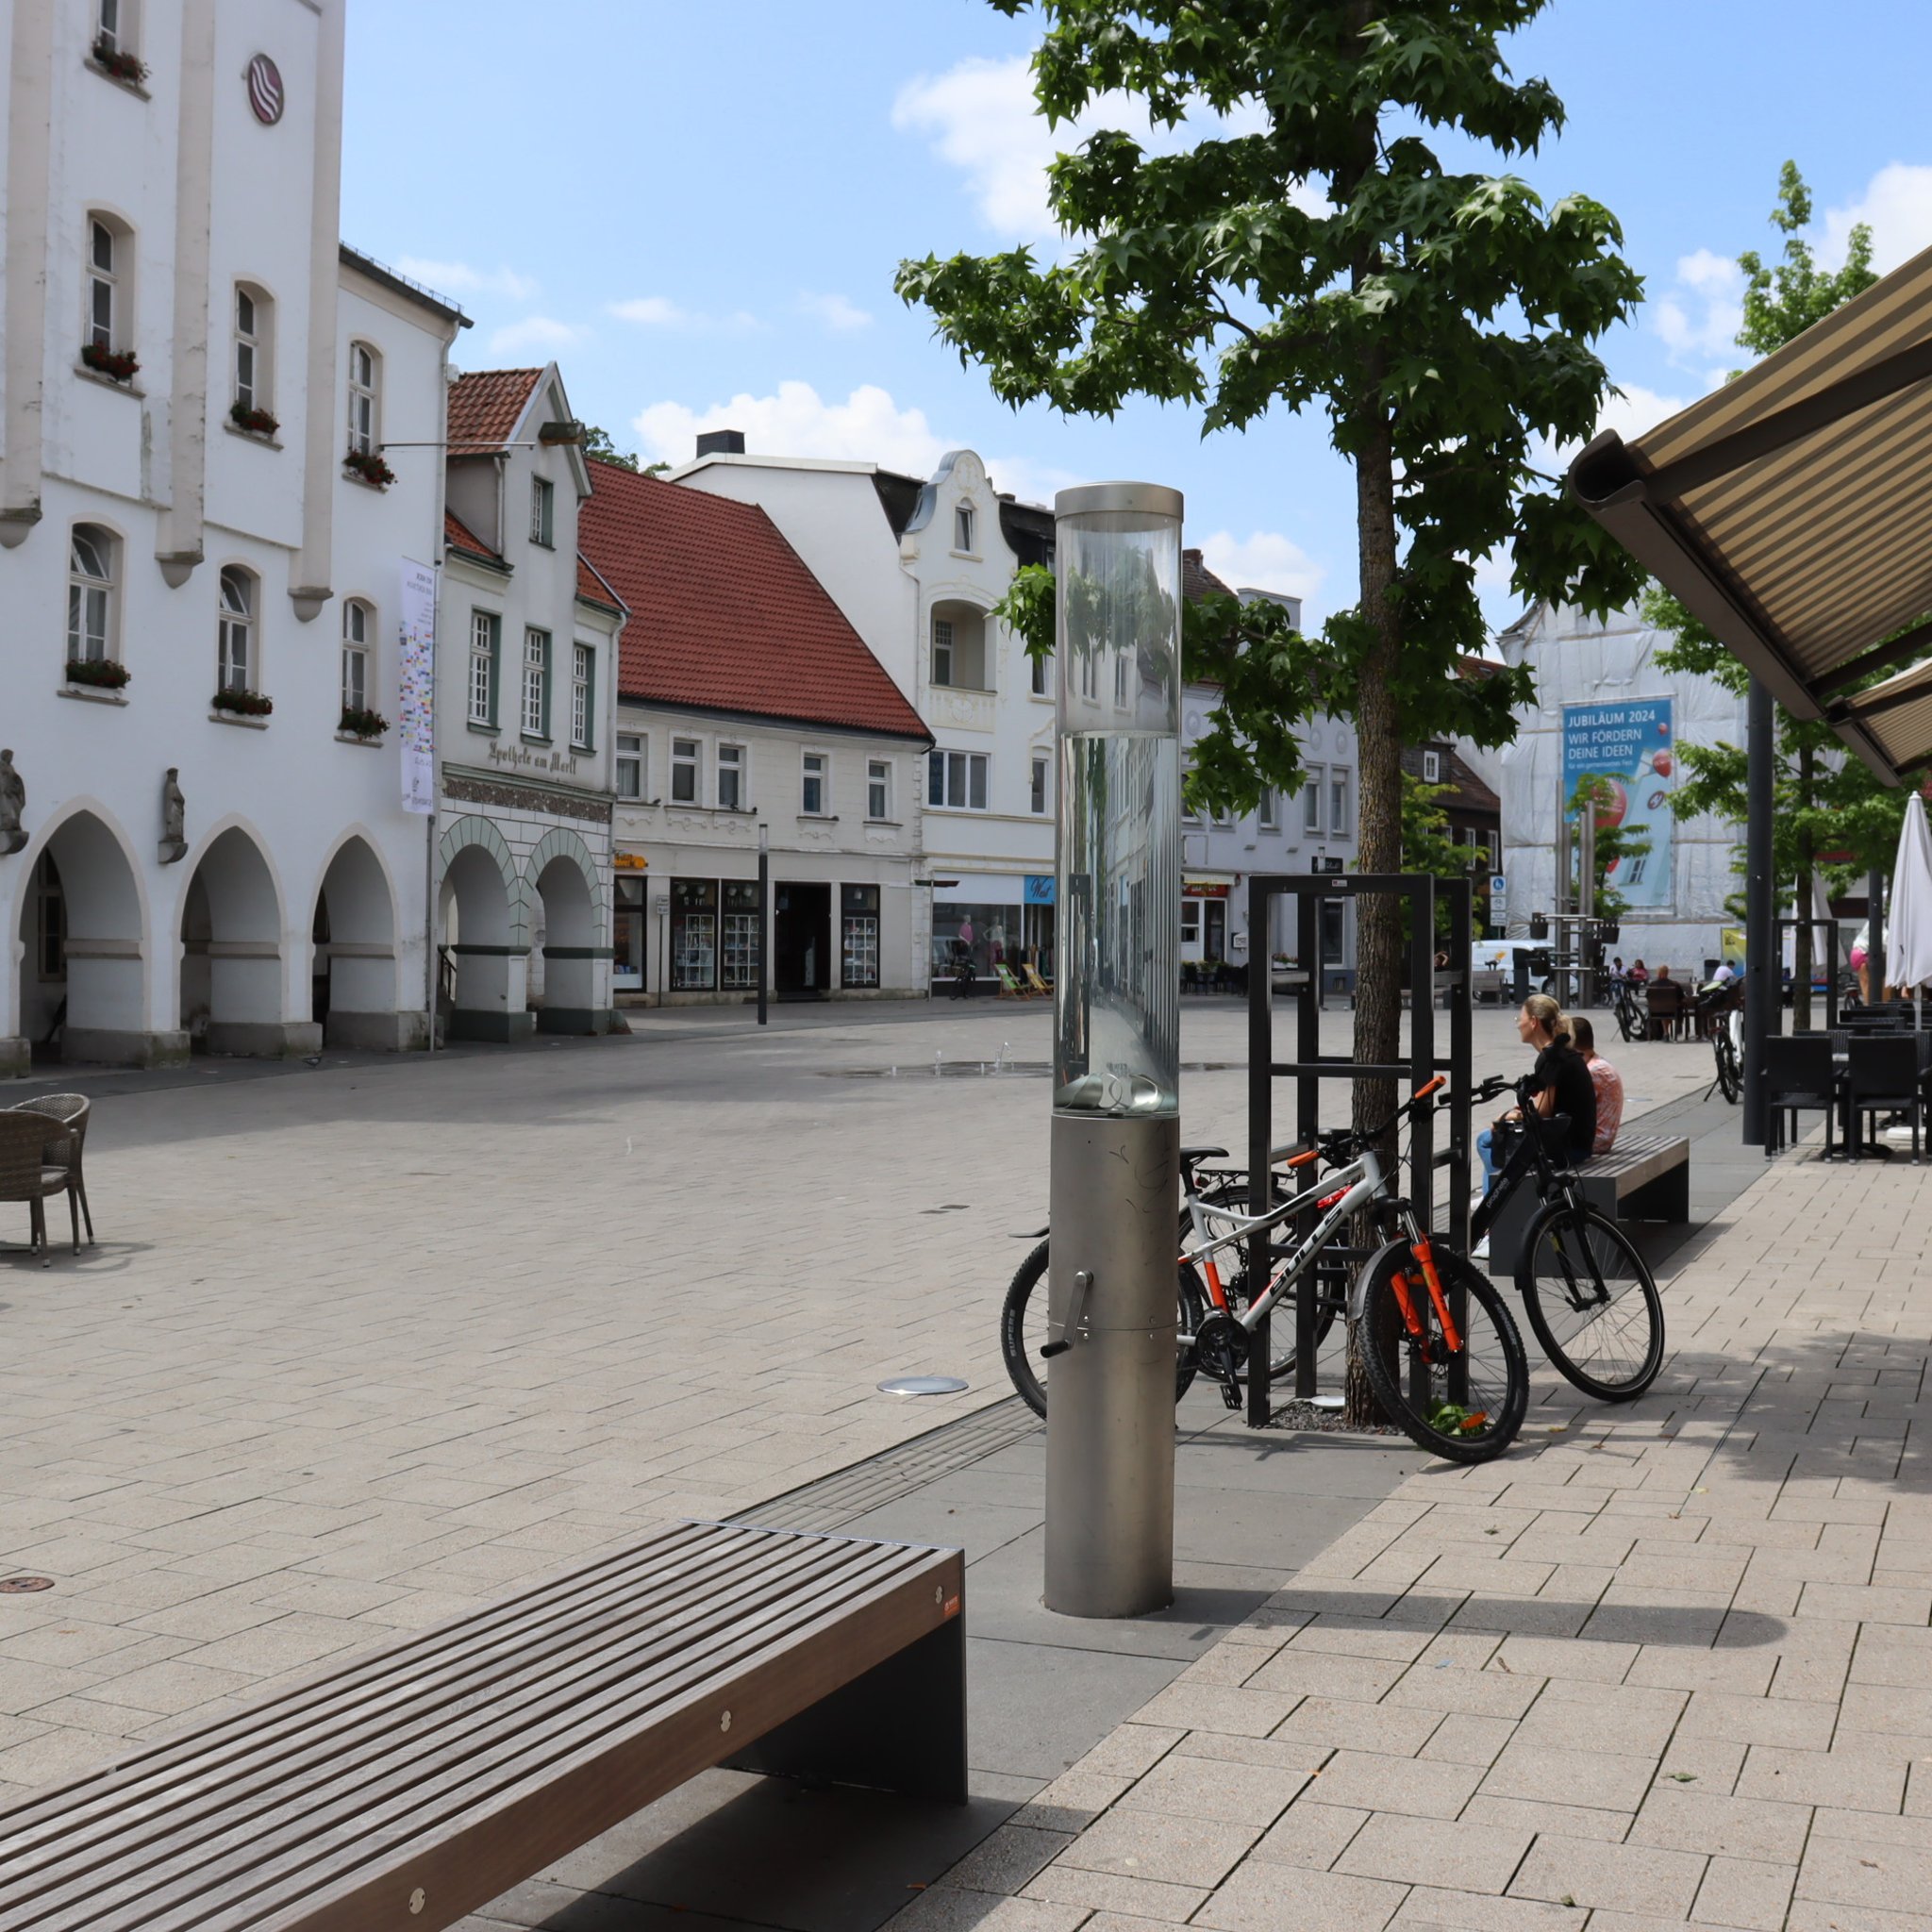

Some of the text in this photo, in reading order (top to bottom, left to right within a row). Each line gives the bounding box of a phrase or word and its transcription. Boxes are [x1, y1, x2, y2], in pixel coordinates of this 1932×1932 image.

[1568, 709, 1656, 727] JUBILÄUM 2024
[1568, 729, 1642, 745] WIR FÖRDERN
[1569, 744, 1634, 760] DEINE IDEEN
[534, 756, 547, 769] am
[1270, 1206, 1343, 1297] BULLS
